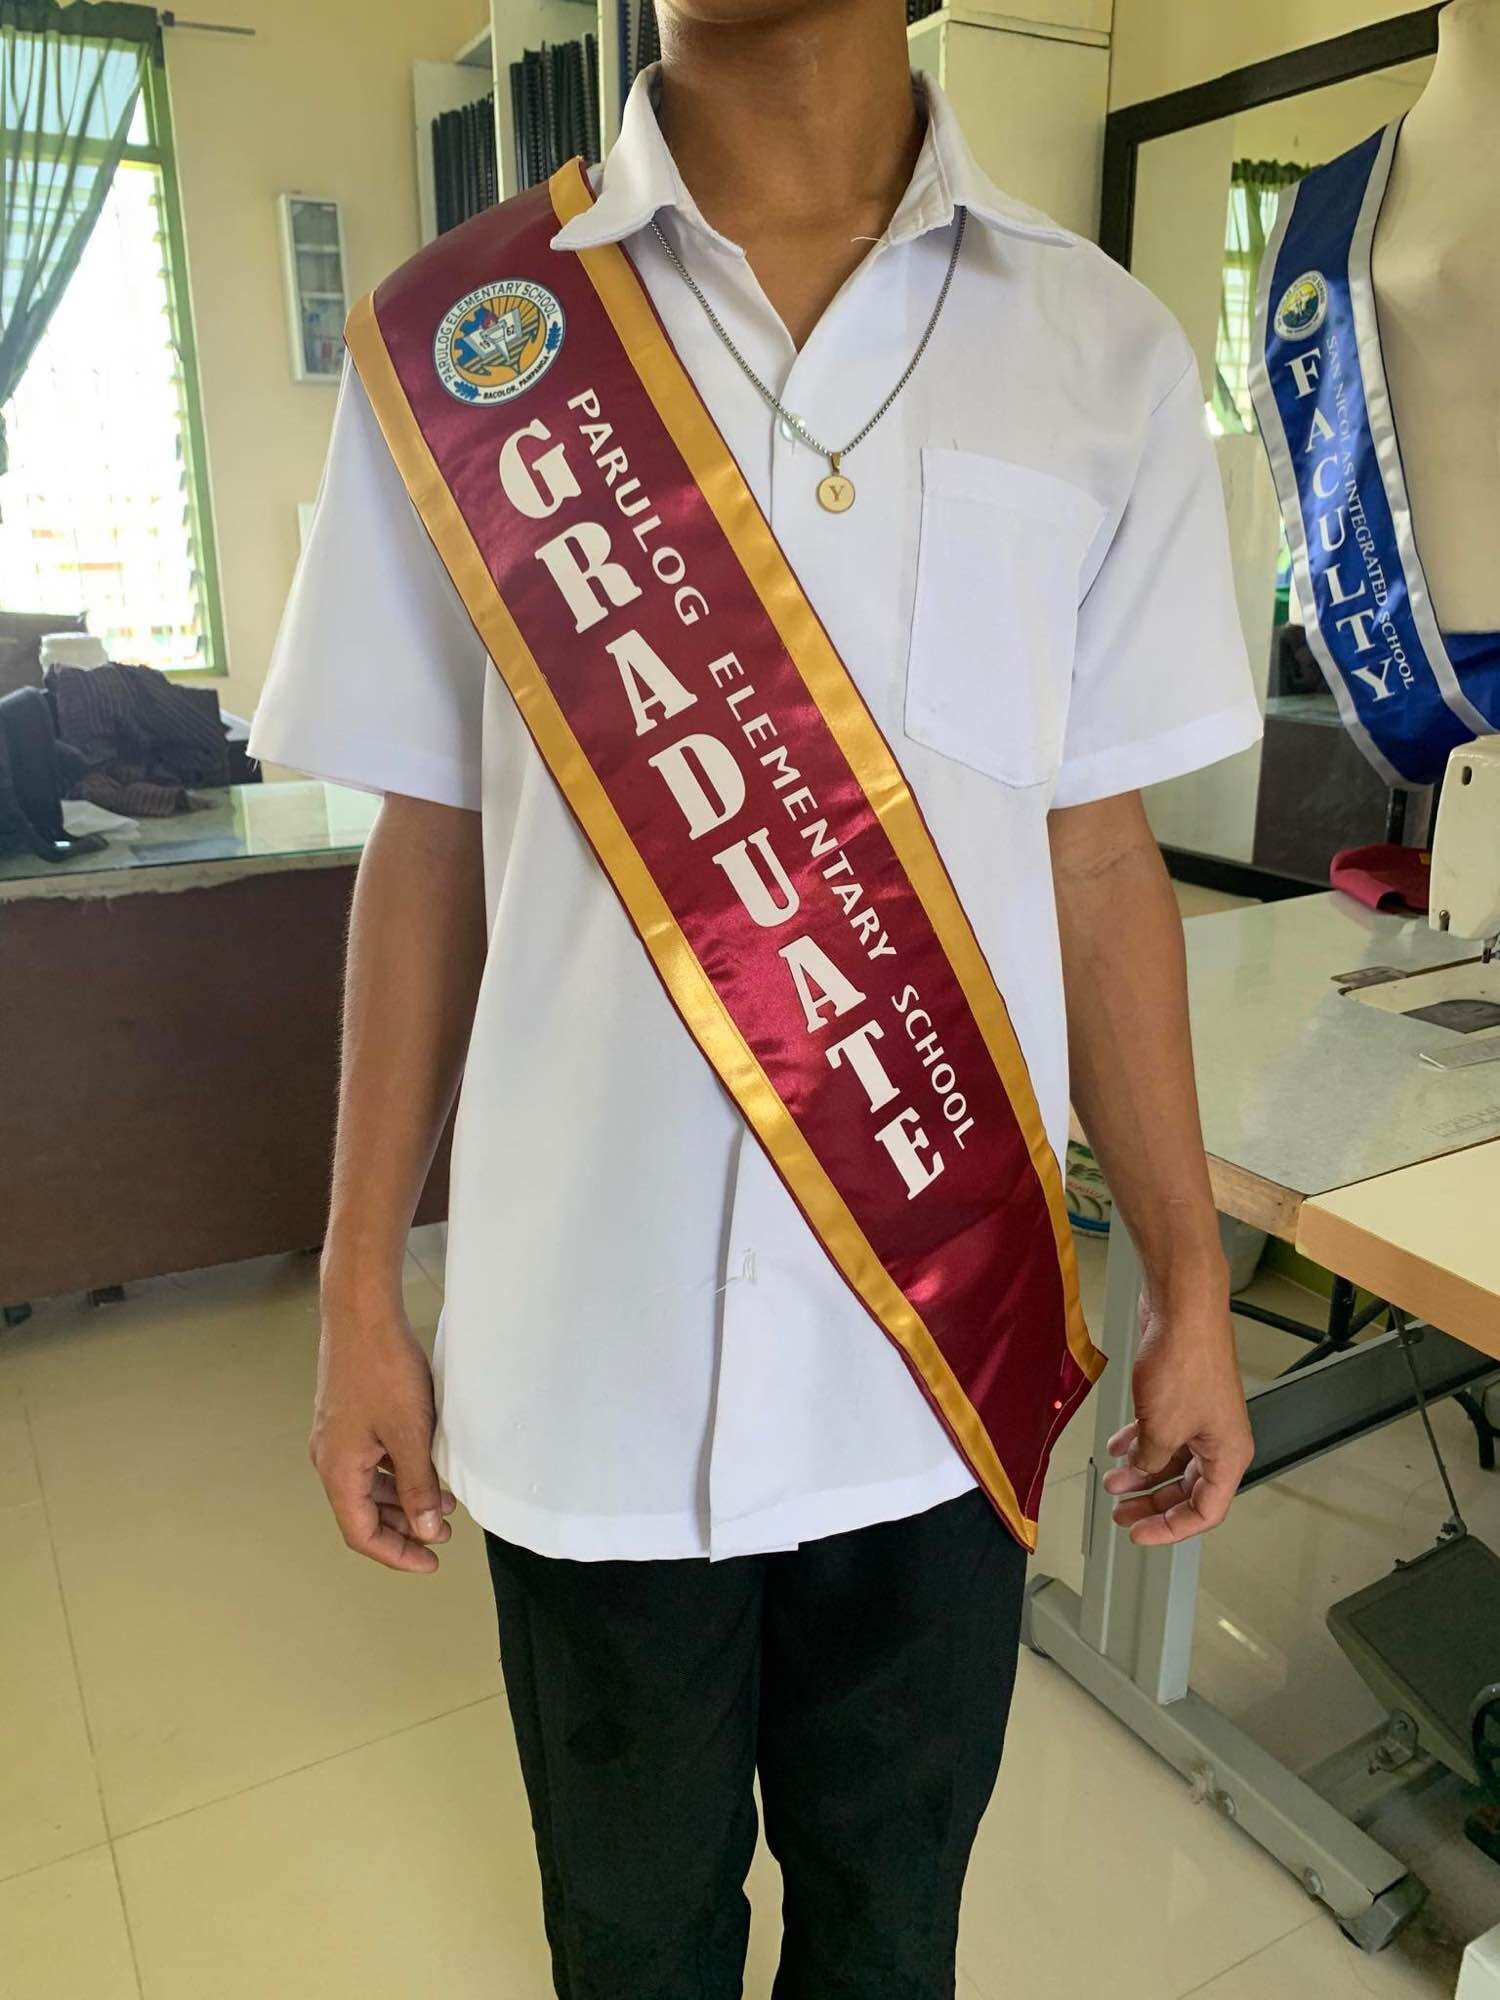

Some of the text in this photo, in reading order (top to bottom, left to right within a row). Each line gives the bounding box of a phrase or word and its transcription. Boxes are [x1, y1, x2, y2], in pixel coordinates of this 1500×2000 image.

[437, 282, 558, 383] PARULOG ELEMENTARY SCHOOL
[829, 485, 844, 502] Y
[1284, 348, 1395, 702] FACULTY
[1344, 480, 1389, 607] INTEGRATED
[1378, 611, 1415, 690] SCHOOL
[499, 418, 945, 1201] GRADUATE
[567, 388, 976, 1150] PARULOG ELEMENTARY SCHOOL
